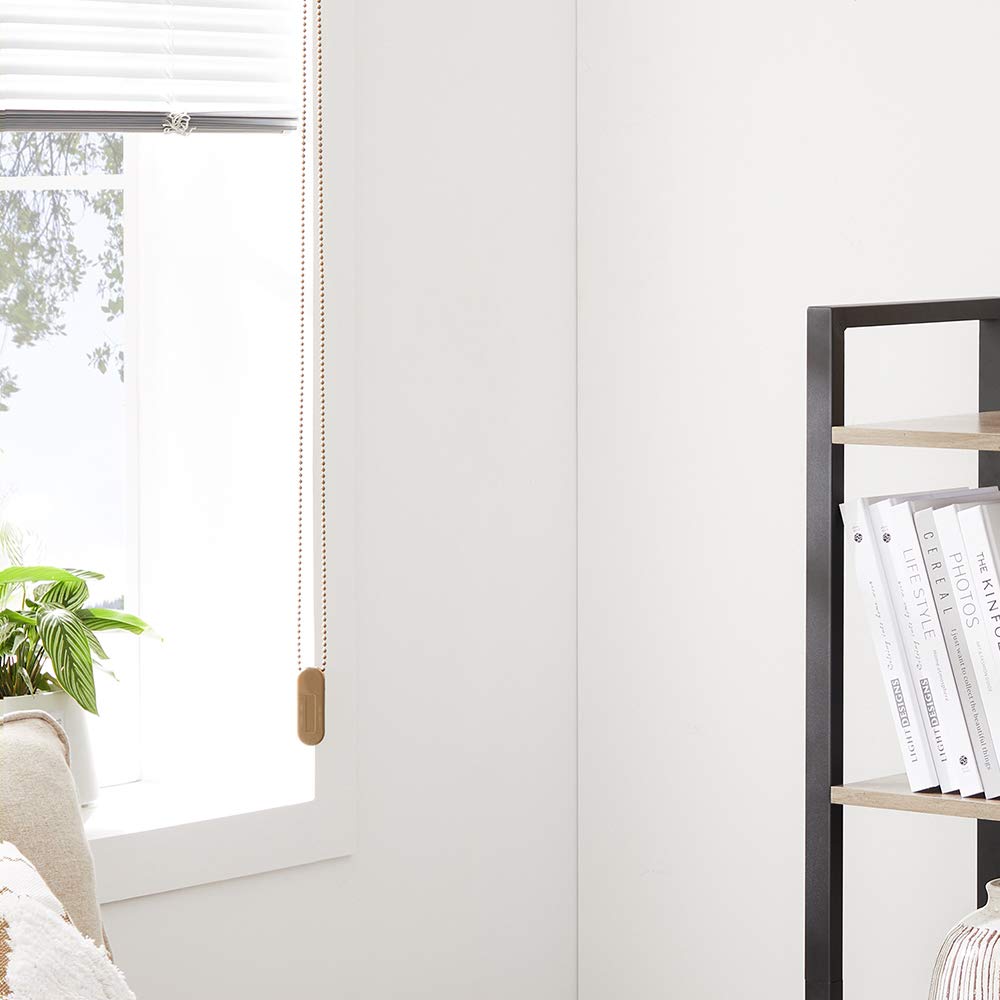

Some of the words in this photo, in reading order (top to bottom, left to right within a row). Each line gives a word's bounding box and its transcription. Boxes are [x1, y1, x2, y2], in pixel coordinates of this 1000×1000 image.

[924, 531, 952, 614] CEREAL
[976, 552, 988, 574] THE
[949, 552, 980, 628] PHOTOS
[956, 647, 965, 666] want
[961, 666, 967, 676] to
[891, 678, 910, 728] DESIGNS
[920, 678, 939, 727] DESIGNS
[962, 675, 973, 700] collect
[904, 728, 918, 762] LIGHT
[934, 729, 947, 762] LIGHT
[972, 712, 986, 746] beautiful
[982, 746, 992, 770] things
